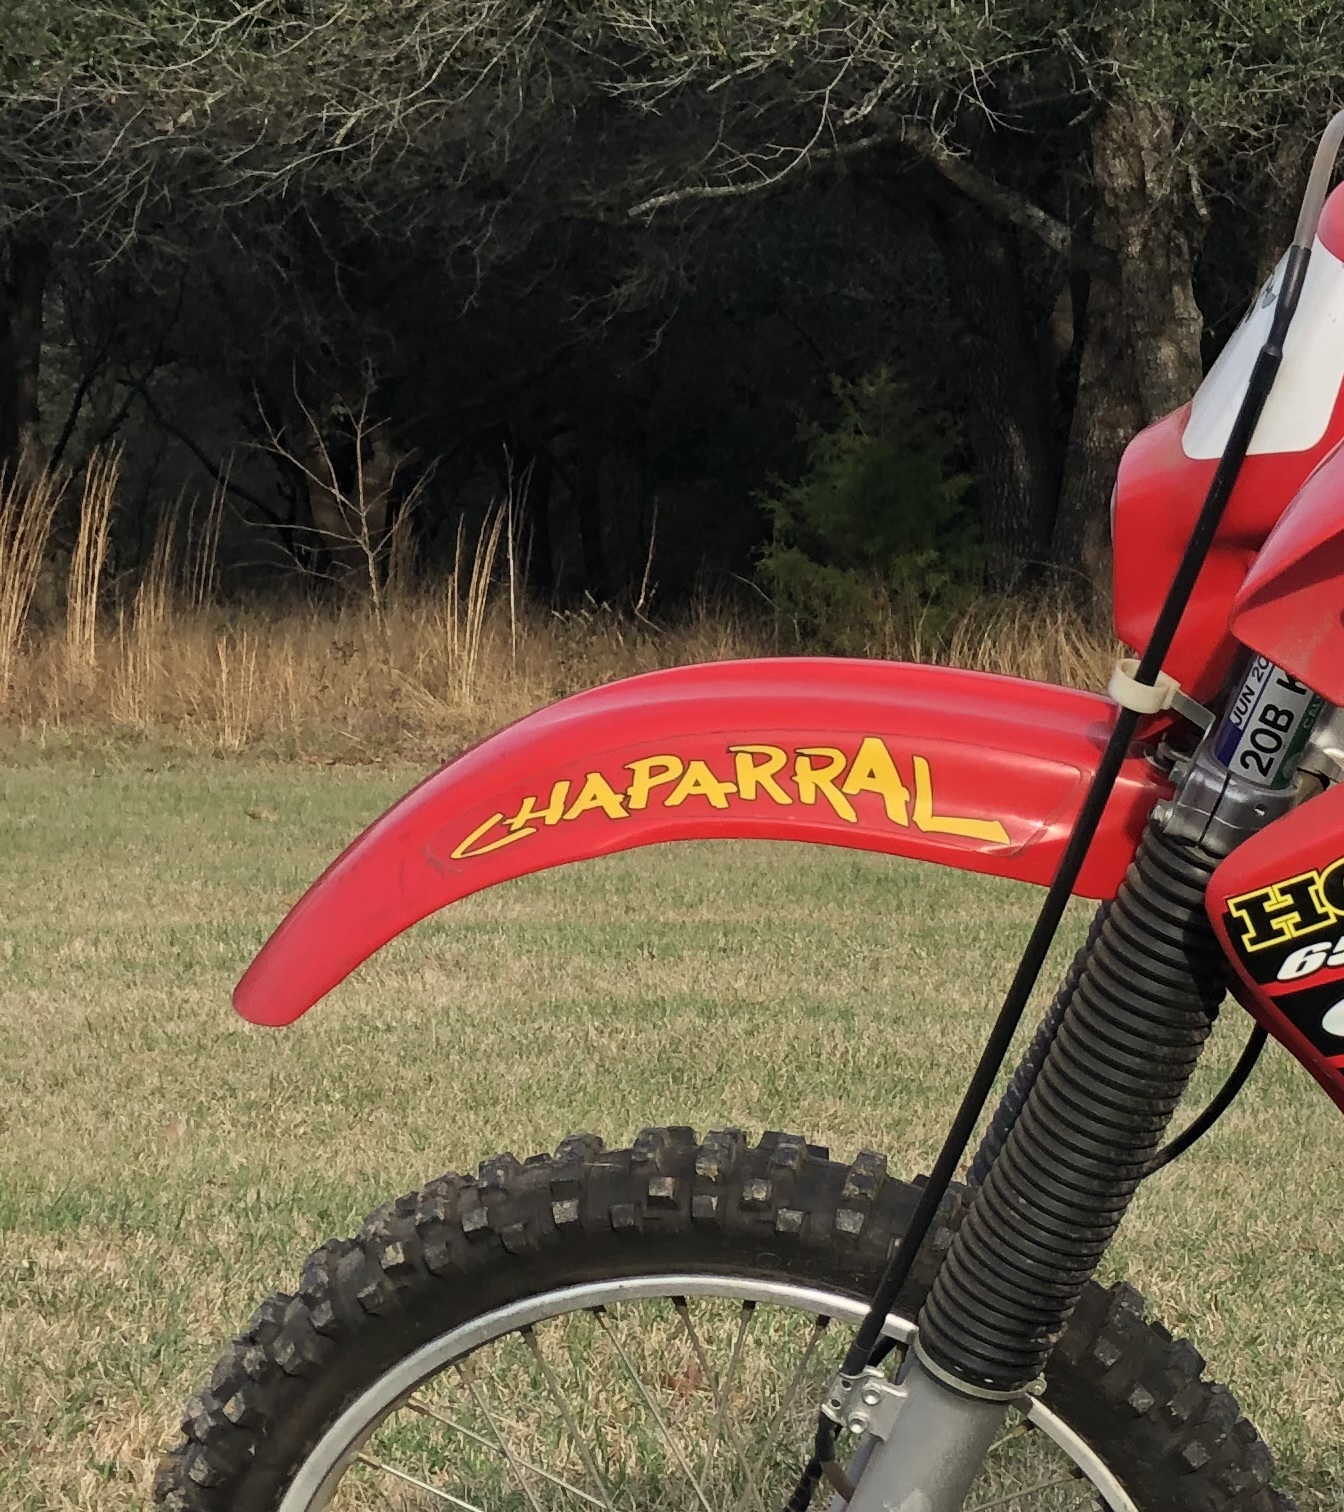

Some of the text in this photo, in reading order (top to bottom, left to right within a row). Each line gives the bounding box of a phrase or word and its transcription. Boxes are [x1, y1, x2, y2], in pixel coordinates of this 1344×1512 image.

[1233, 684, 1256, 726] JUN
[1240, 703, 1295, 777] 20B
[451, 737, 1011, 860] CHAPARRAL
